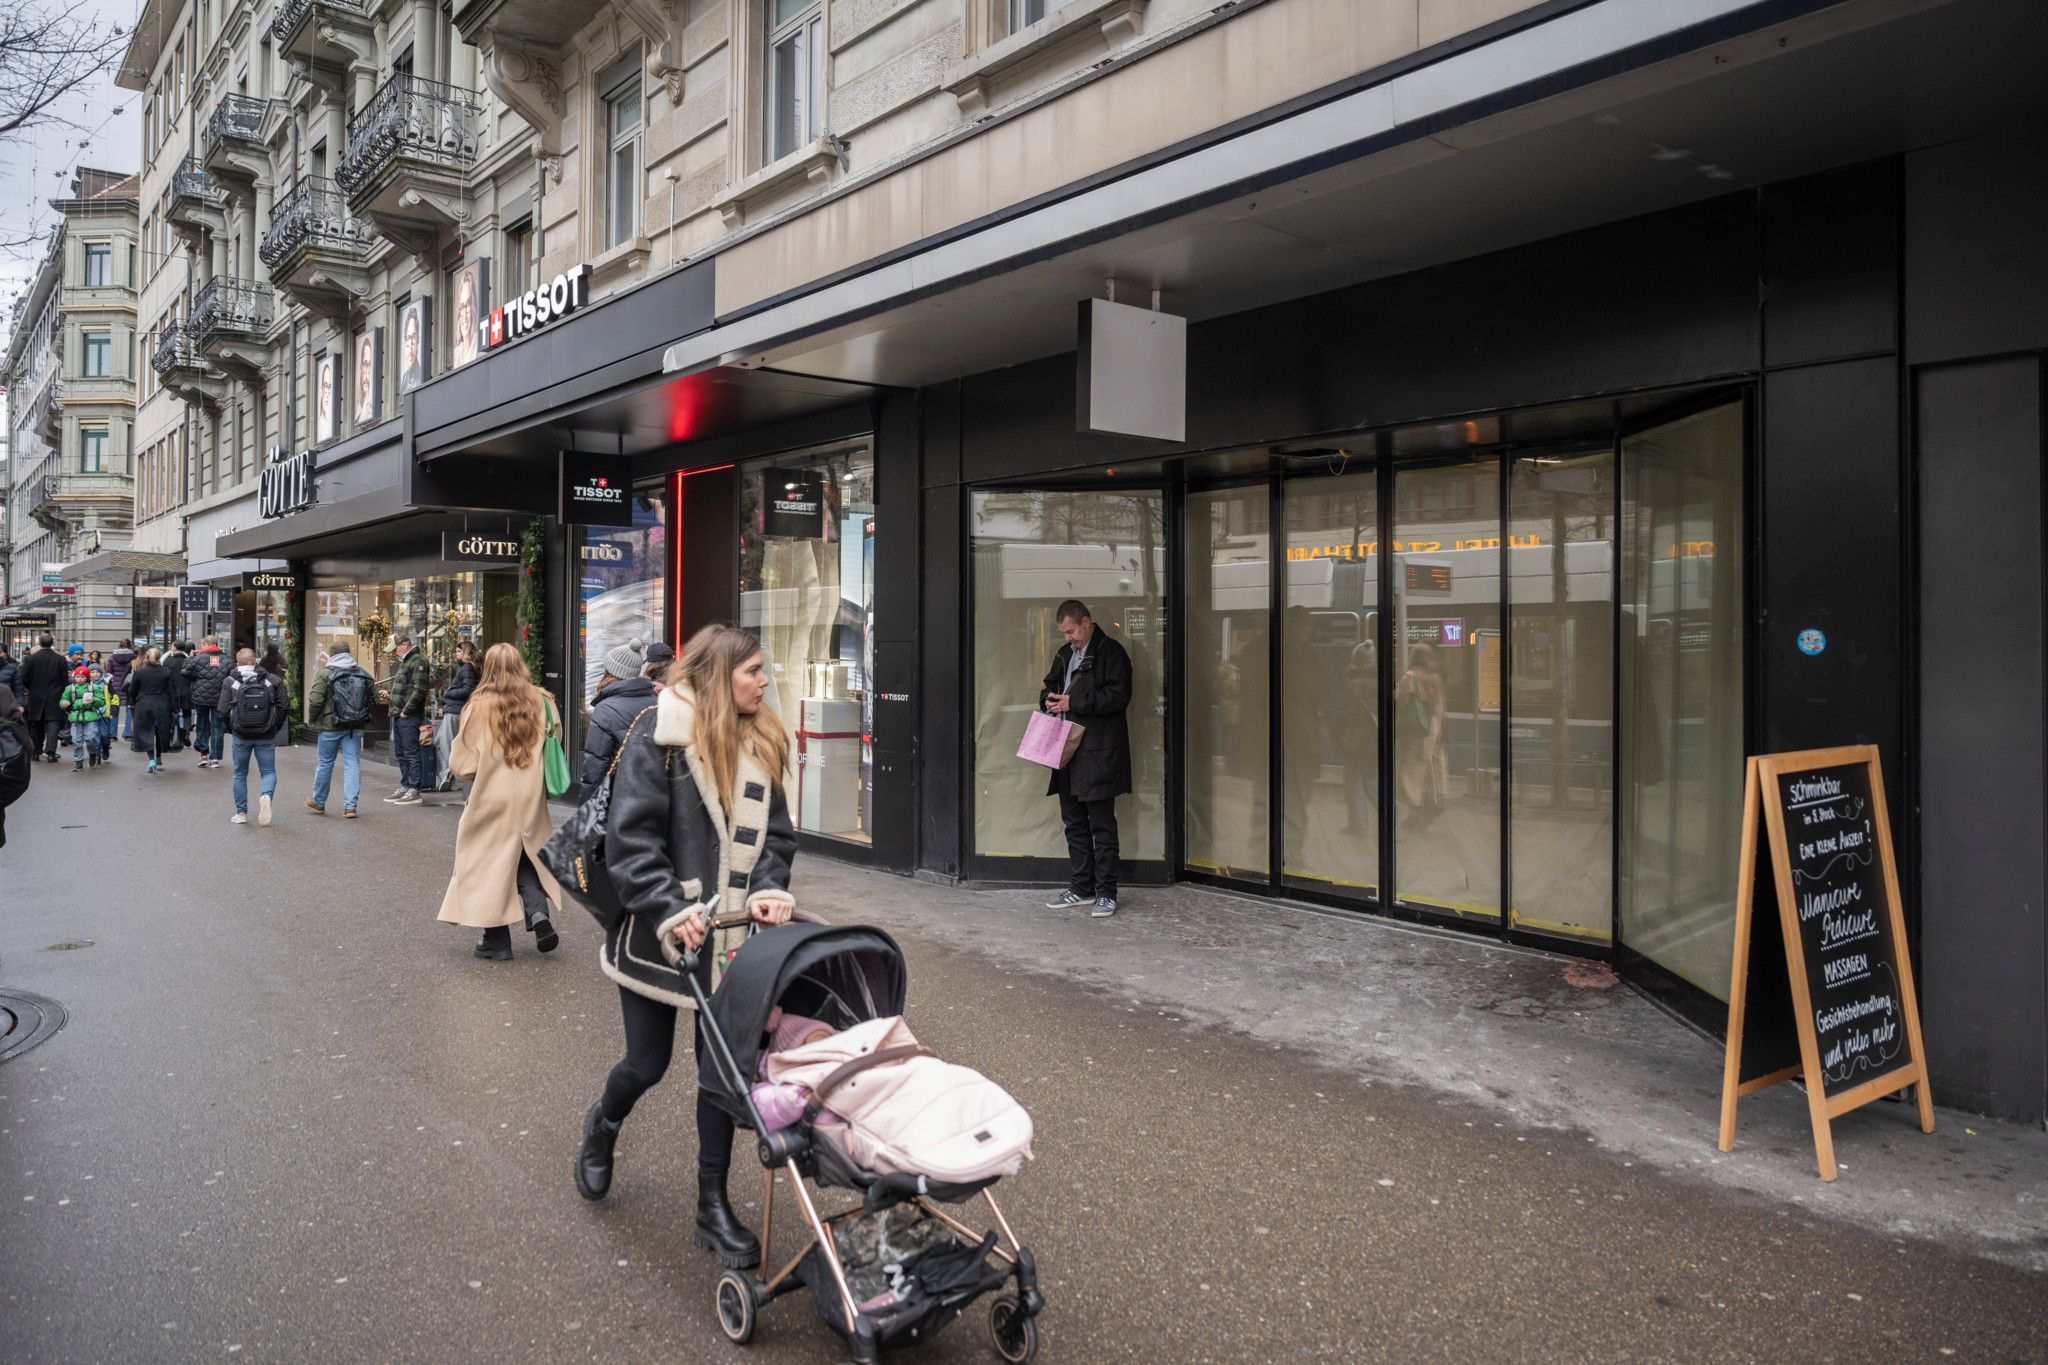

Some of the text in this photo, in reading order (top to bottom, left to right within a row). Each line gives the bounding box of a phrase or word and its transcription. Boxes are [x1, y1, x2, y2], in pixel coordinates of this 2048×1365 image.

[503, 263, 585, 338] TISSOT
[257, 444, 310, 519] GÖTTE
[573, 486, 622, 499] TISSOT
[458, 536, 518, 556] GÖTTE
[252, 574, 295, 587] GÖTTE
[888, 693, 909, 702] TISSOT
[797, 752, 807, 764] OF
[808, 754, 826, 767] TIME
[1790, 775, 1842, 804] schminkbar
[1799, 881, 1862, 922] Manicure
[1821, 907, 1877, 946] Pedicure
[1823, 953, 1868, 984] MASSAGEN
[1816, 994, 1892, 1034] Gesichtsbehandlung
[1824, 1017, 1896, 1069] und vieles mehr
